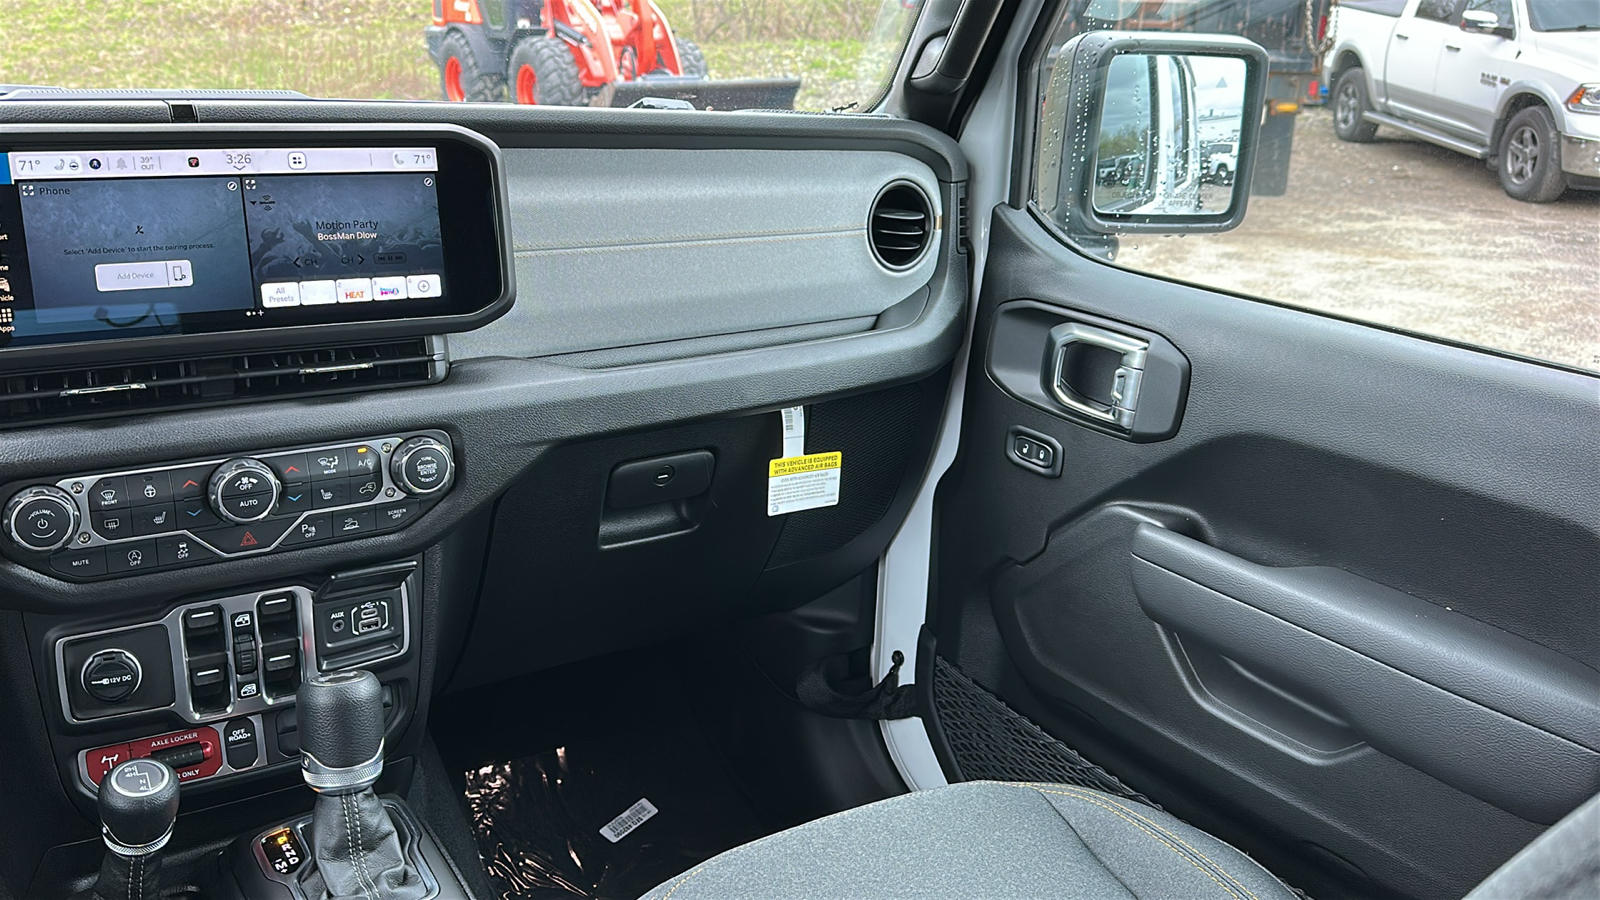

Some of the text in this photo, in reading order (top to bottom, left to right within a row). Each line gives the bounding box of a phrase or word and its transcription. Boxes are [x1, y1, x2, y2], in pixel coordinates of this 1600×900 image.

[226, 154, 252, 164] 3:26
[414, 154, 431, 164] 71°
[18, 160, 40, 170] 71°
[40, 187, 70, 195] Phone
[316, 220, 378, 230] Motion Party
[318, 231, 378, 240] BossMan Dlow
[165, 244, 188, 252] pairing
[304, 258, 318, 266] CH
[345, 291, 364, 299] HEAT
[358, 458, 372, 467] A/C
[787, 458, 806, 467] VEHICLE
[417, 463, 438, 471] BROWSE
[788, 464, 814, 472] ADVANCED
[240, 500, 258, 508] AUTO
[388, 508, 406, 516] SCREEN
[302, 524, 308, 533] P
[110, 676, 122, 684] 12V
[232, 728, 246, 736] OFF
[151, 732, 198, 748] AXLE LOCKER
[182, 768, 200, 778] ONLY
[278, 836, 288, 844] P
[284, 849, 296, 858] N
[288, 856, 300, 864] D
[274, 860, 288, 870] M
